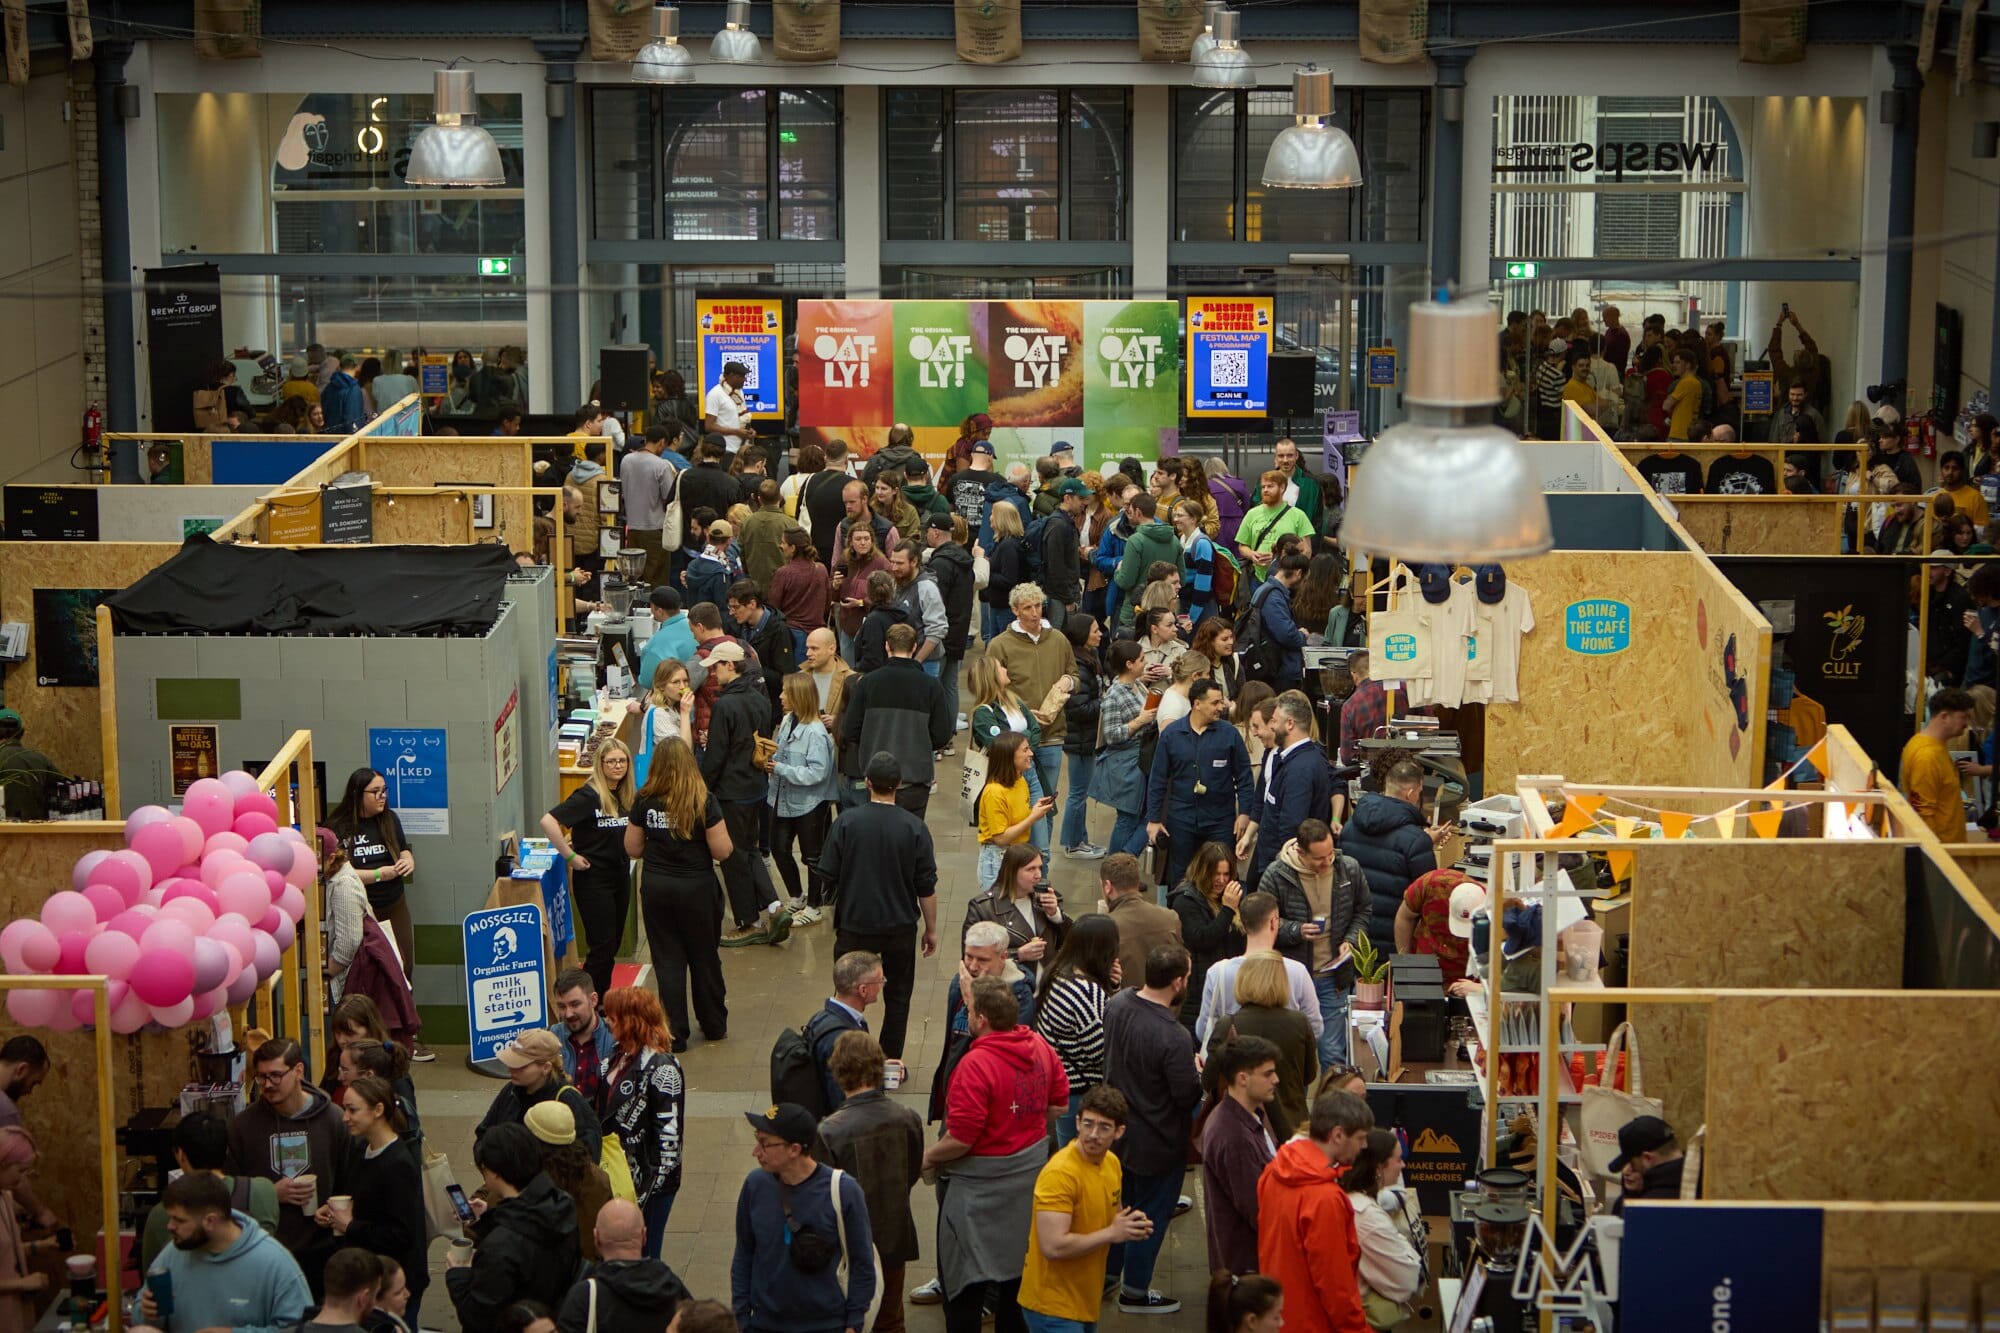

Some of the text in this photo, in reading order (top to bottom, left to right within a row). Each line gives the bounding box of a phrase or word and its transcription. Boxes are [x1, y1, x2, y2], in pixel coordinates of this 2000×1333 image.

[151, 304, 217, 316] BREW-IT GROUP
[824, 361, 870, 388] LY!
[919, 361, 965, 388] LY!
[1015, 361, 1061, 388] LY!
[1110, 361, 1156, 388] LY!
[1577, 604, 1617, 619] BRING
[1570, 618, 1627, 634] THE CAFÉ
[1581, 636, 1616, 650] HOME
[1822, 662, 1862, 675] CULT
[176, 733, 202, 741] BATTLE
[190, 740, 211, 749] OATS
[470, 912, 535, 935] MOSSGIEL
[473, 959, 537, 976] Organic Farm
[493, 976, 521, 990] milk
[488, 986, 527, 1002] re-fill
[484, 998, 532, 1014] station
[1407, 1162, 1467, 1171] MAKE GREAT
[1410, 1173, 1462, 1182] MEMORIES
